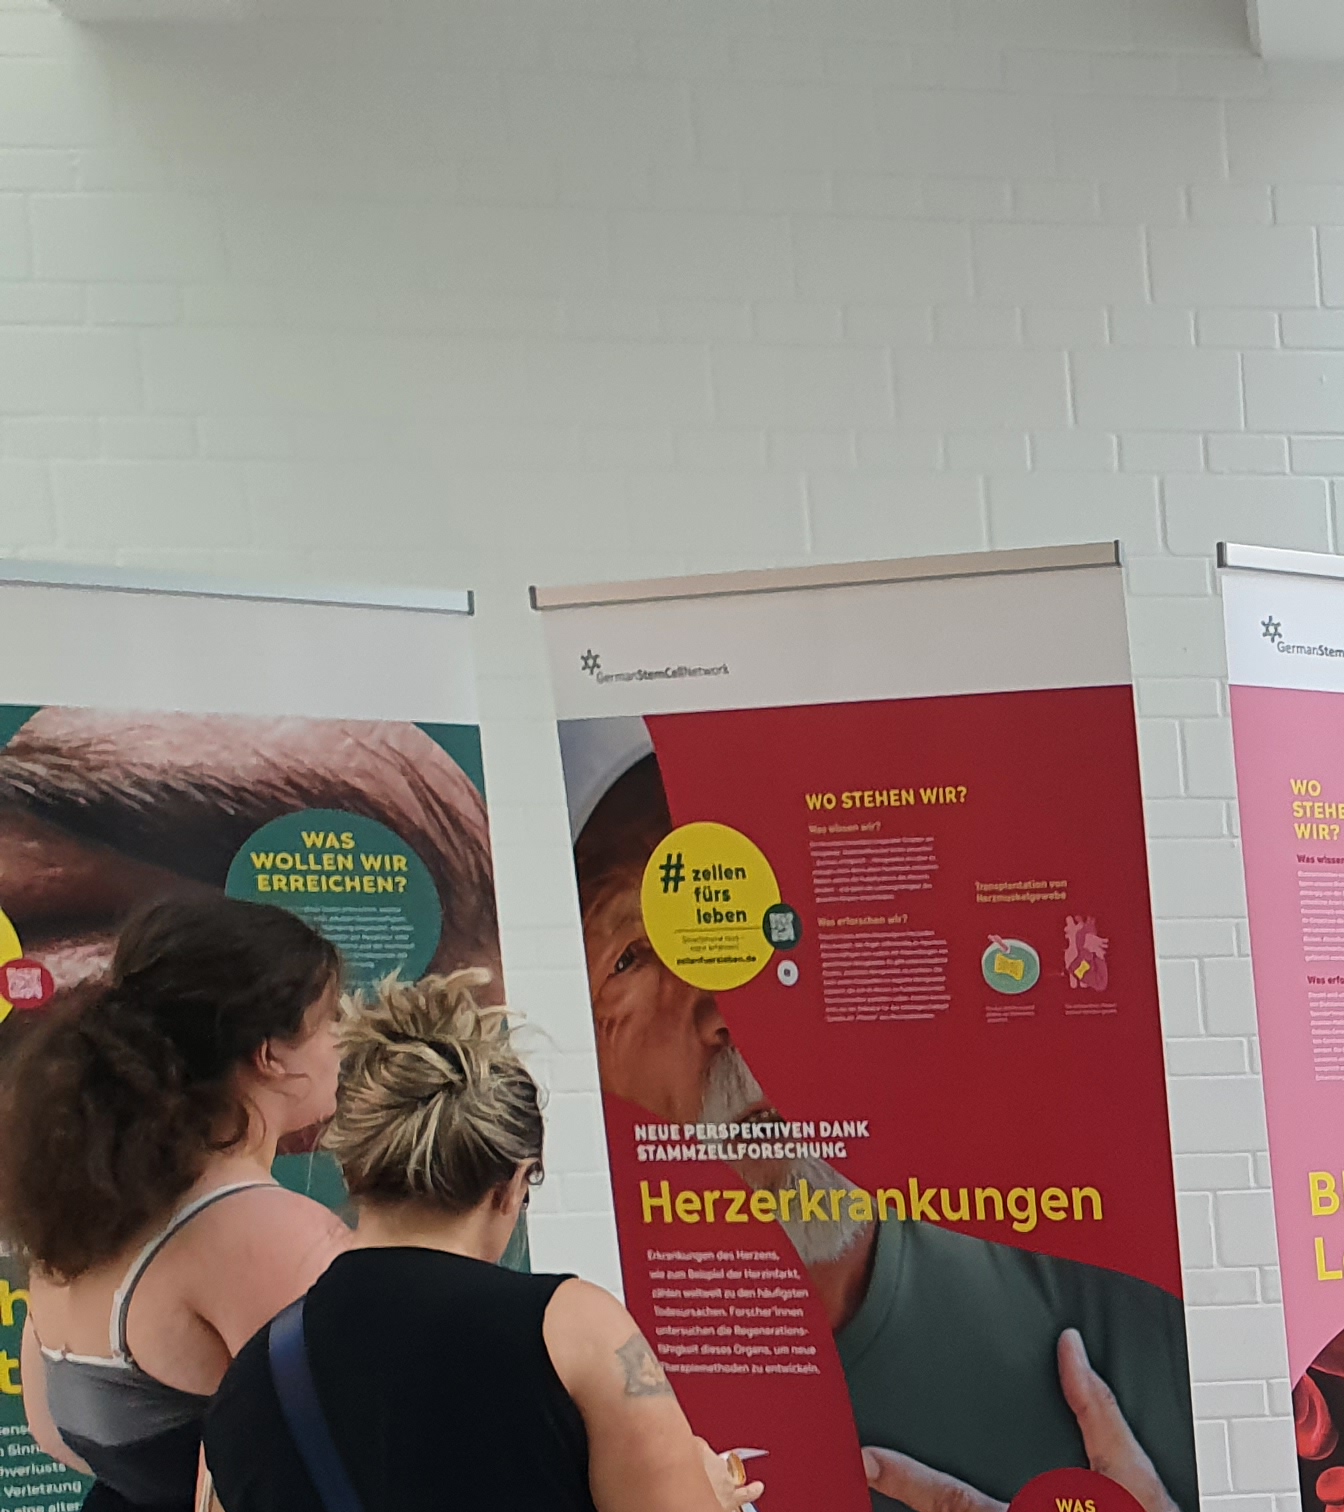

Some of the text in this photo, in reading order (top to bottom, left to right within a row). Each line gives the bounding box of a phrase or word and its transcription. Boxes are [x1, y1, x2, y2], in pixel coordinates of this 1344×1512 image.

[1290, 778, 1322, 797] WO
[806, 786, 968, 811] WO STEHEN WIR?
[301, 831, 356, 850] WAS
[1294, 824, 1340, 841] WIR?
[250, 852, 408, 872] WOLLEN WIR
[256, 873, 408, 893] ERREICHEN?
[659, 853, 747, 893] # zellen
[694, 887, 731, 904] fürs
[696, 908, 747, 925] leben
[635, 1119, 870, 1141] NEUE PERSPEKTIVEN DANK
[636, 1141, 848, 1162] STAMMZELLFORSCHUNG
[639, 1178, 1103, 1233] Herzerkrankungen
